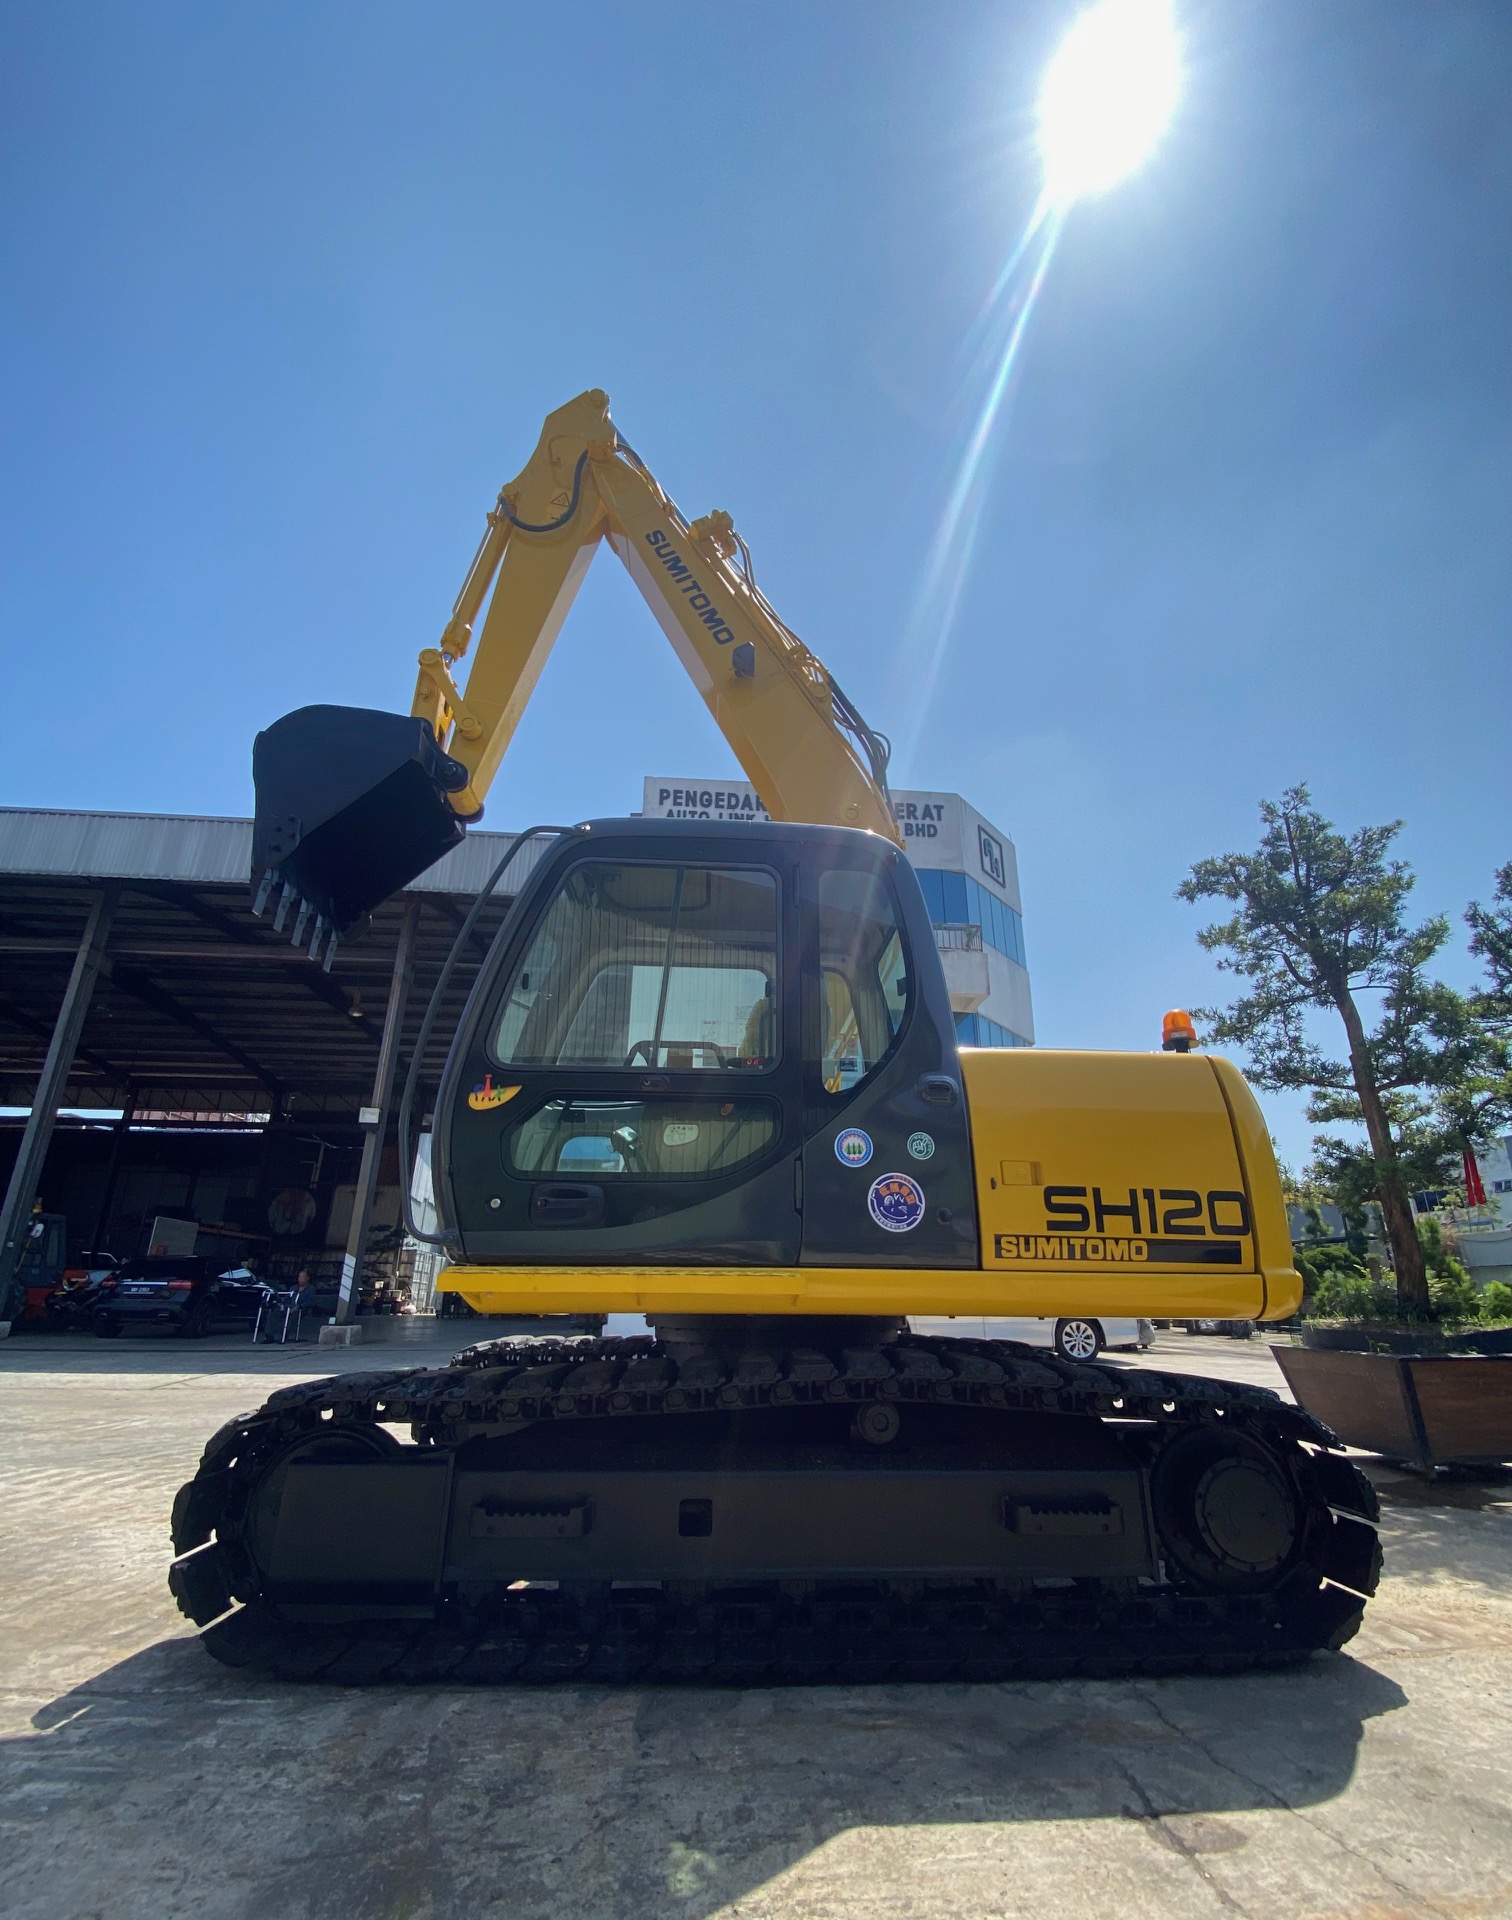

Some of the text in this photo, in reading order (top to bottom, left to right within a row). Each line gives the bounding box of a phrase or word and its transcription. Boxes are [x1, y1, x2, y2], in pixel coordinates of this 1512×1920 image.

[645, 529, 735, 645] SUMITOMO
[904, 822, 938, 838] BHD
[1043, 1185, 1251, 1236] SH120
[1000, 1235, 1148, 1262] SUMITOMO
